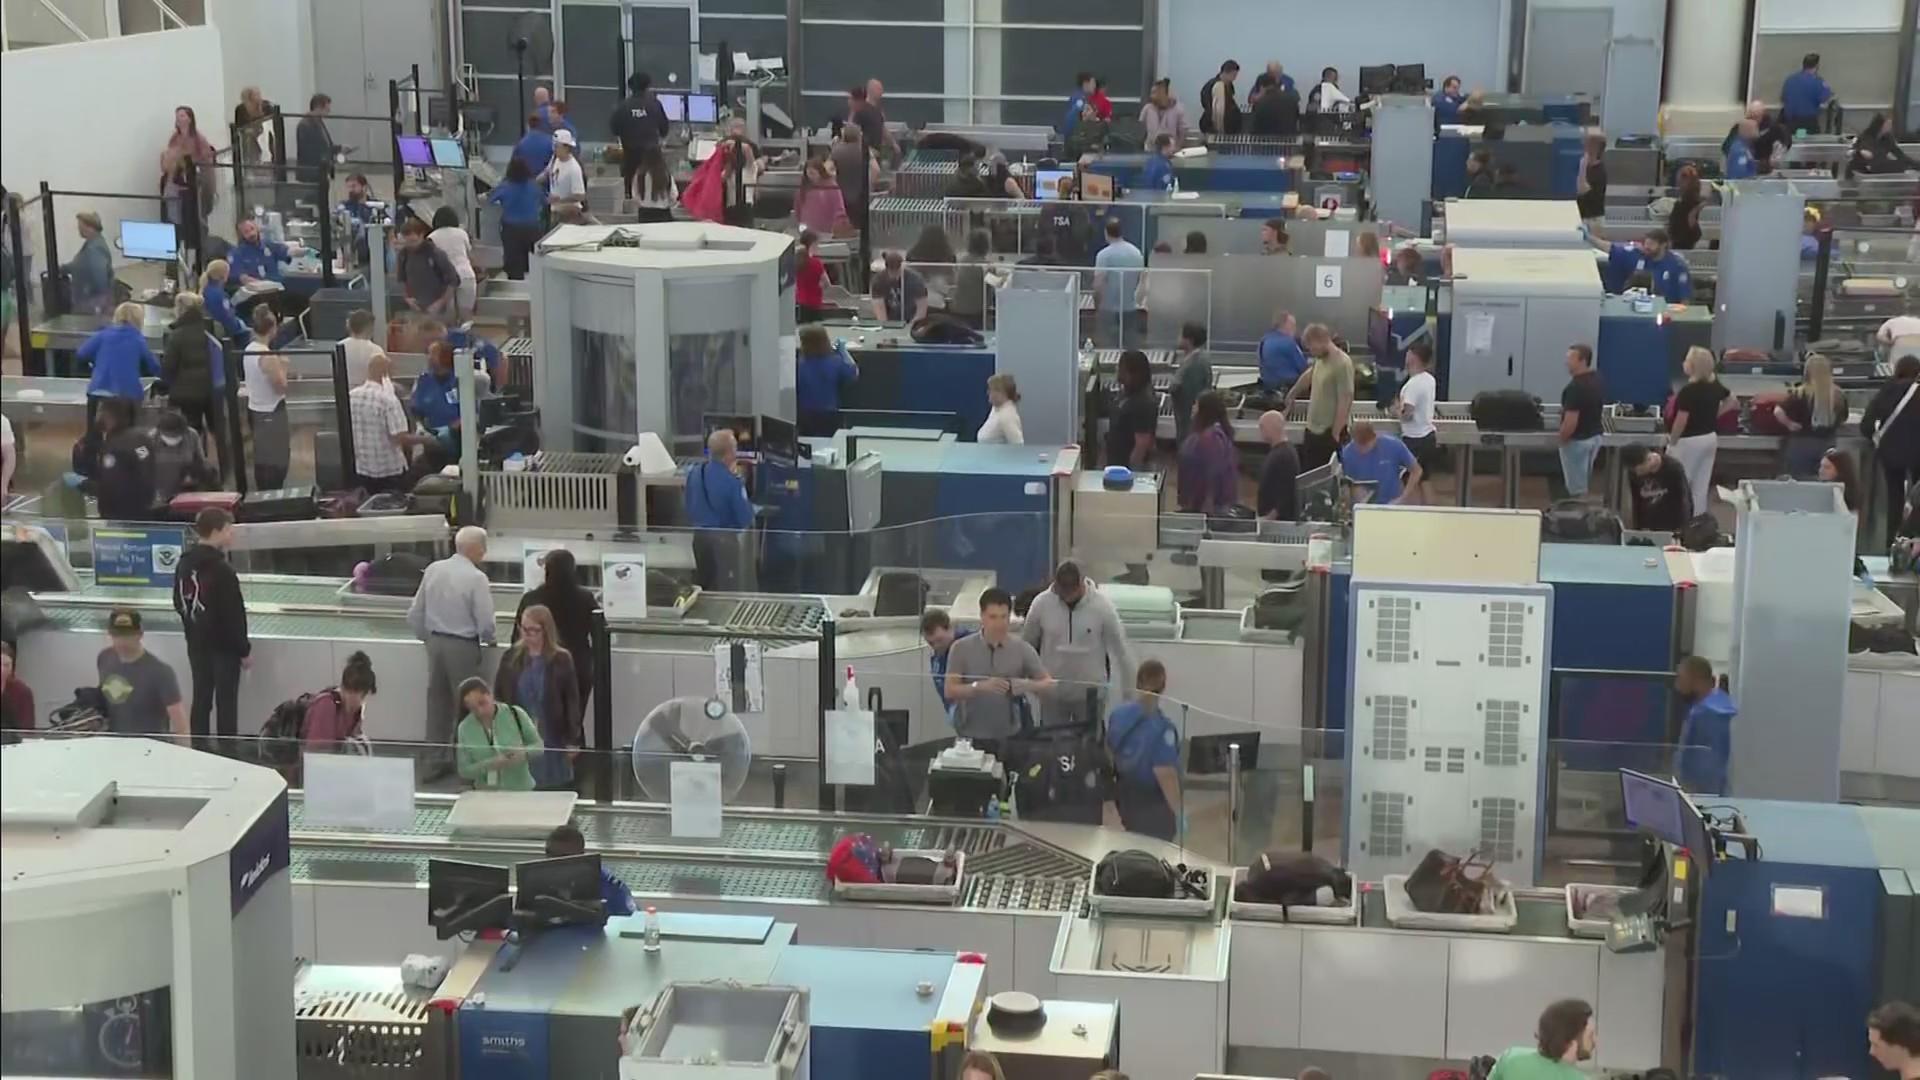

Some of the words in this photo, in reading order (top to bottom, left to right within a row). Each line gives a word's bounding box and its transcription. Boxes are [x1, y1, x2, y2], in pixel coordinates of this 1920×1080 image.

[631, 109, 648, 118] TSA
[1053, 216, 1071, 227] TSA
[1324, 274, 1333, 288] 6
[481, 1035, 526, 1048] smiths
